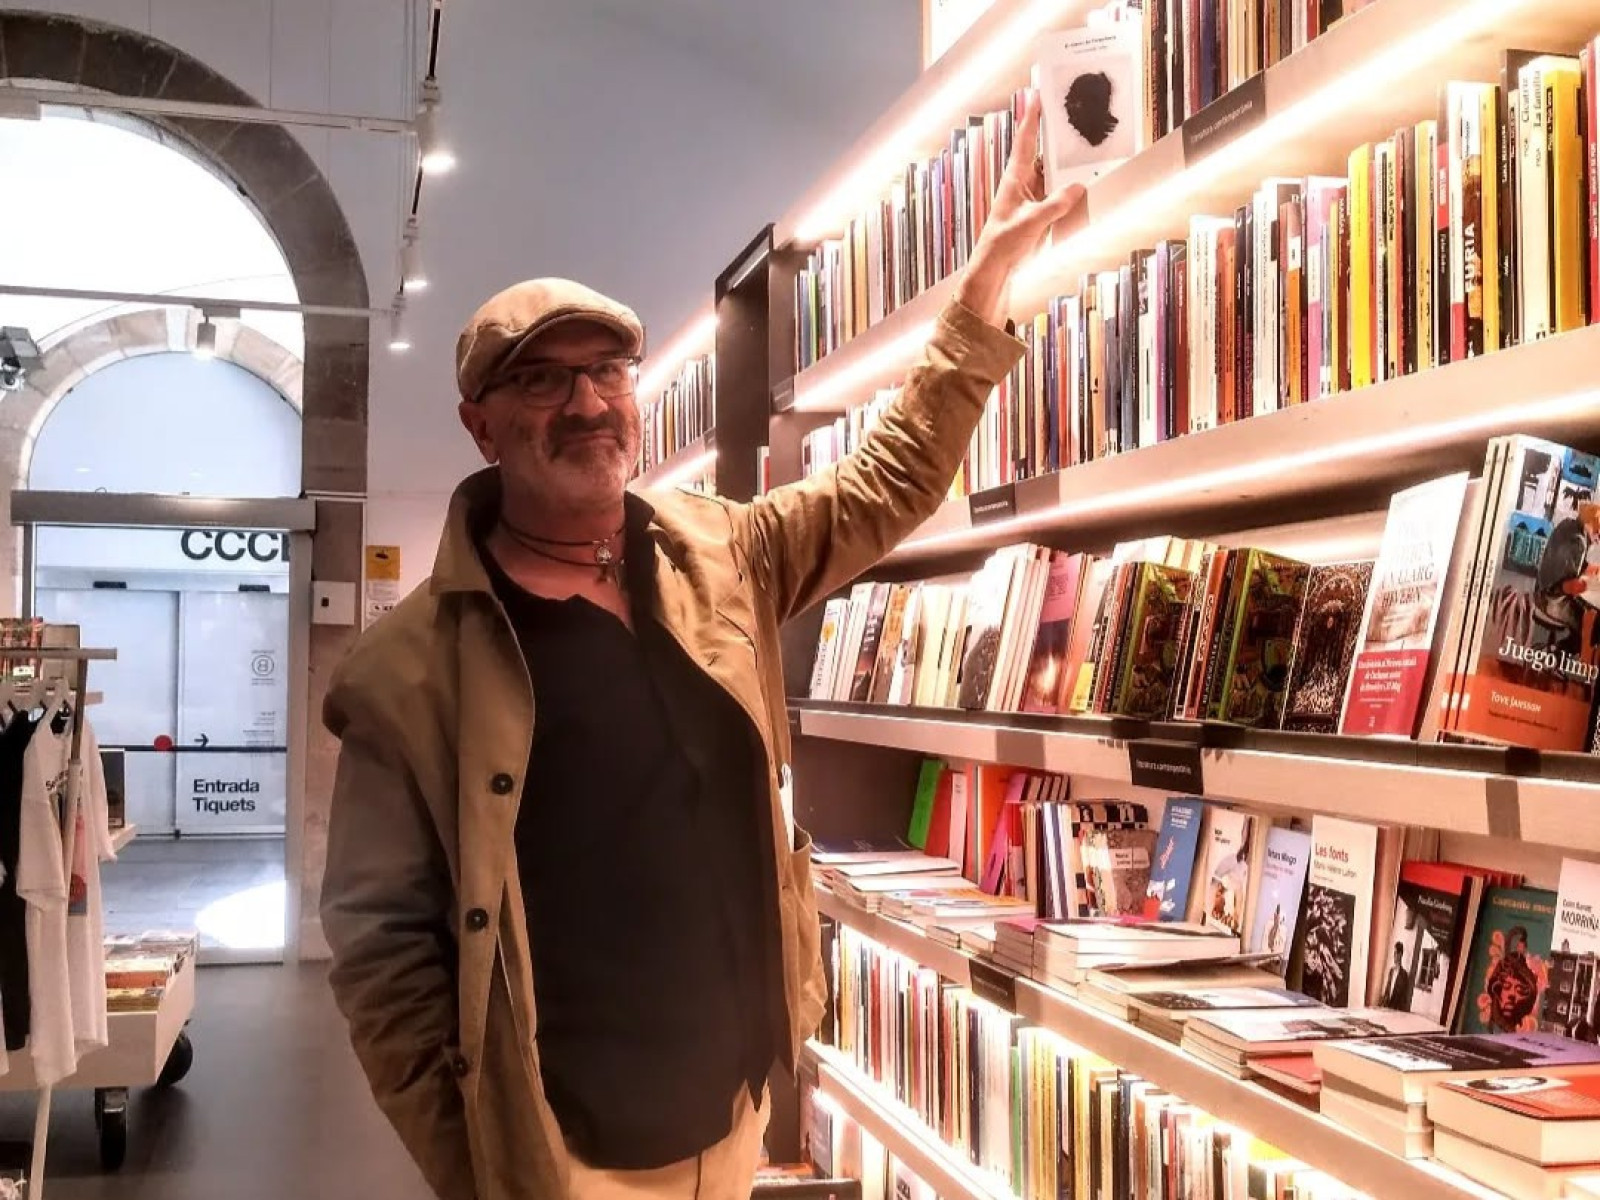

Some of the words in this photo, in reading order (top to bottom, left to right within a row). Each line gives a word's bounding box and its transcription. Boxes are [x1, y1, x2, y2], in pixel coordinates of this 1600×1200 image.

[1532, 112, 1542, 127] La
[1464, 222, 1476, 294] FURIA
[1498, 635, 1557, 672] Juego
[193, 778, 260, 794] Entrada
[192, 796, 256, 815] Tiquets
[1315, 842, 1327, 858] Les
[1329, 845, 1349, 863] fonts
[1560, 909, 1599, 931] MORRIÑA
